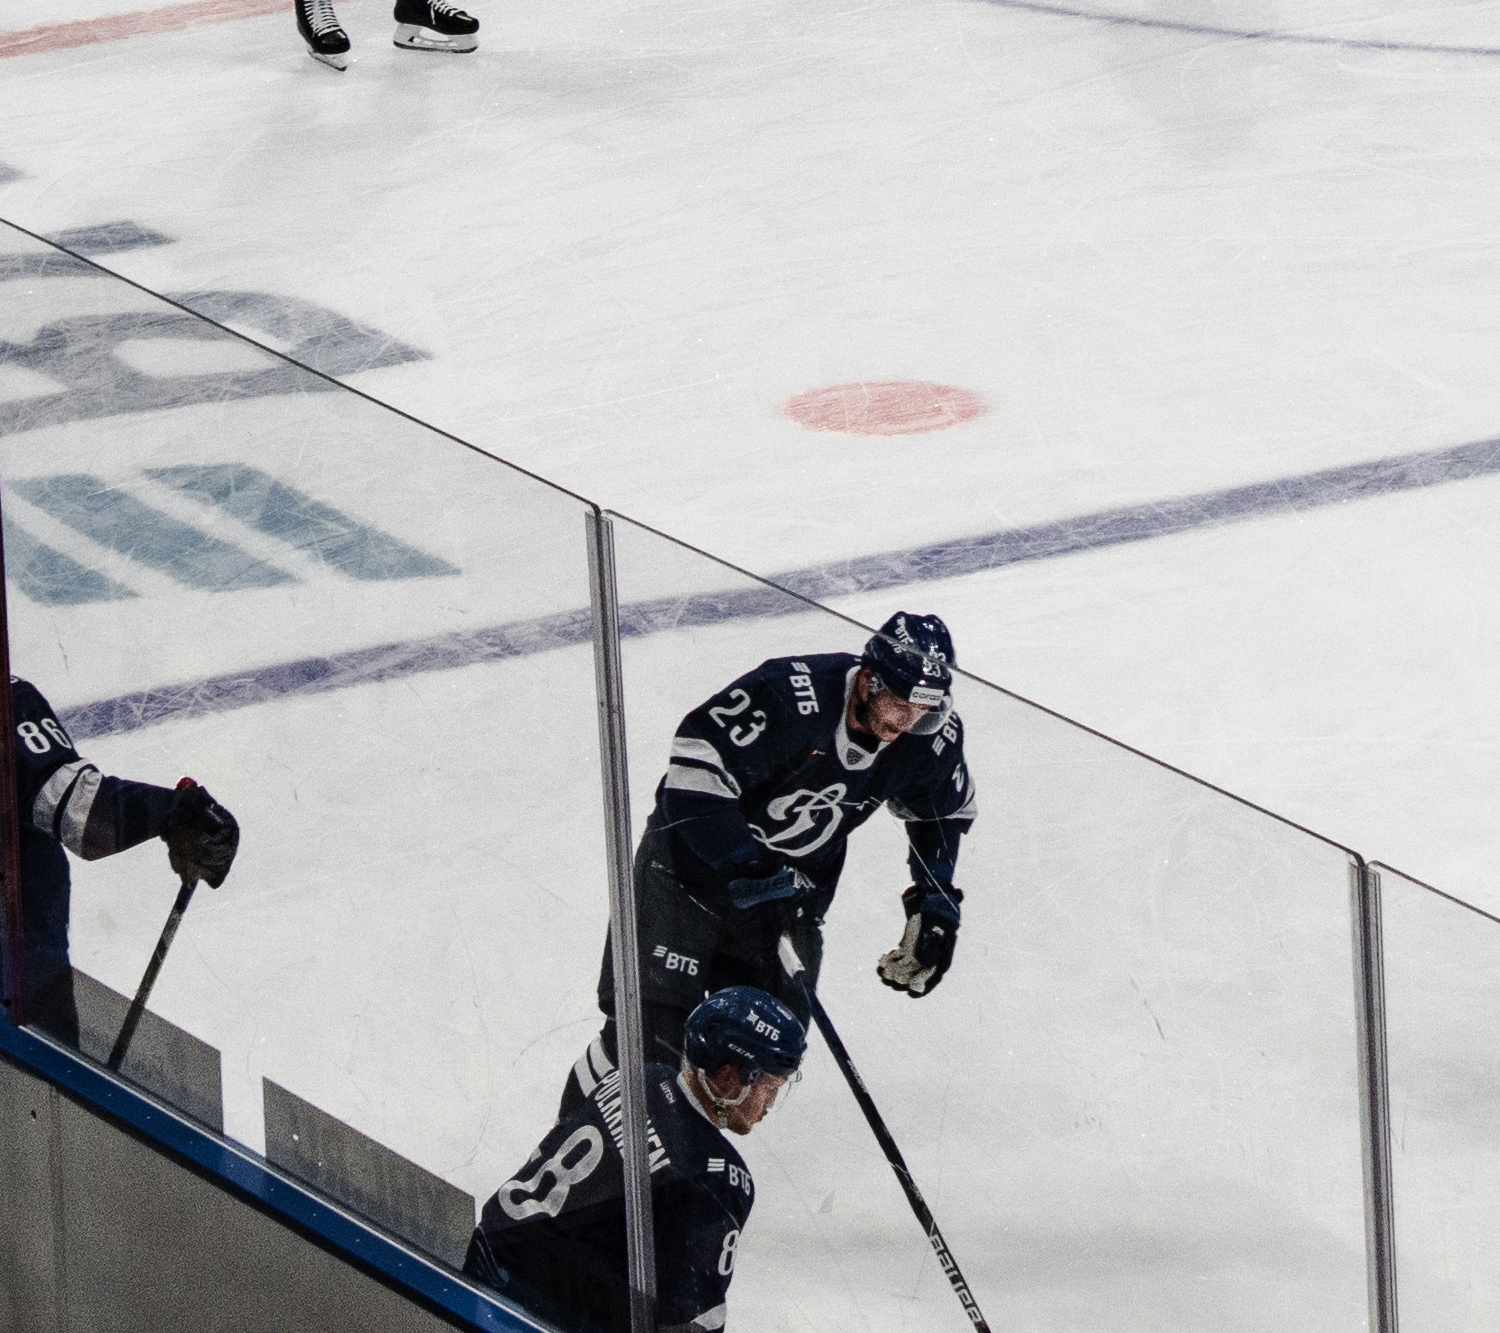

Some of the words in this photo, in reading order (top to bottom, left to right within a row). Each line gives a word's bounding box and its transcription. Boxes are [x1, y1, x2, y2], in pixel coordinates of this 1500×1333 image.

[788, 673, 820, 716] ВТБ
[16, 715, 73, 756] 86
[708, 687, 768, 749] 23
[664, 951, 700, 977] ВТБ
[754, 1019, 782, 1043] ВТБ
[727, 1162, 752, 1196] ВТБ
